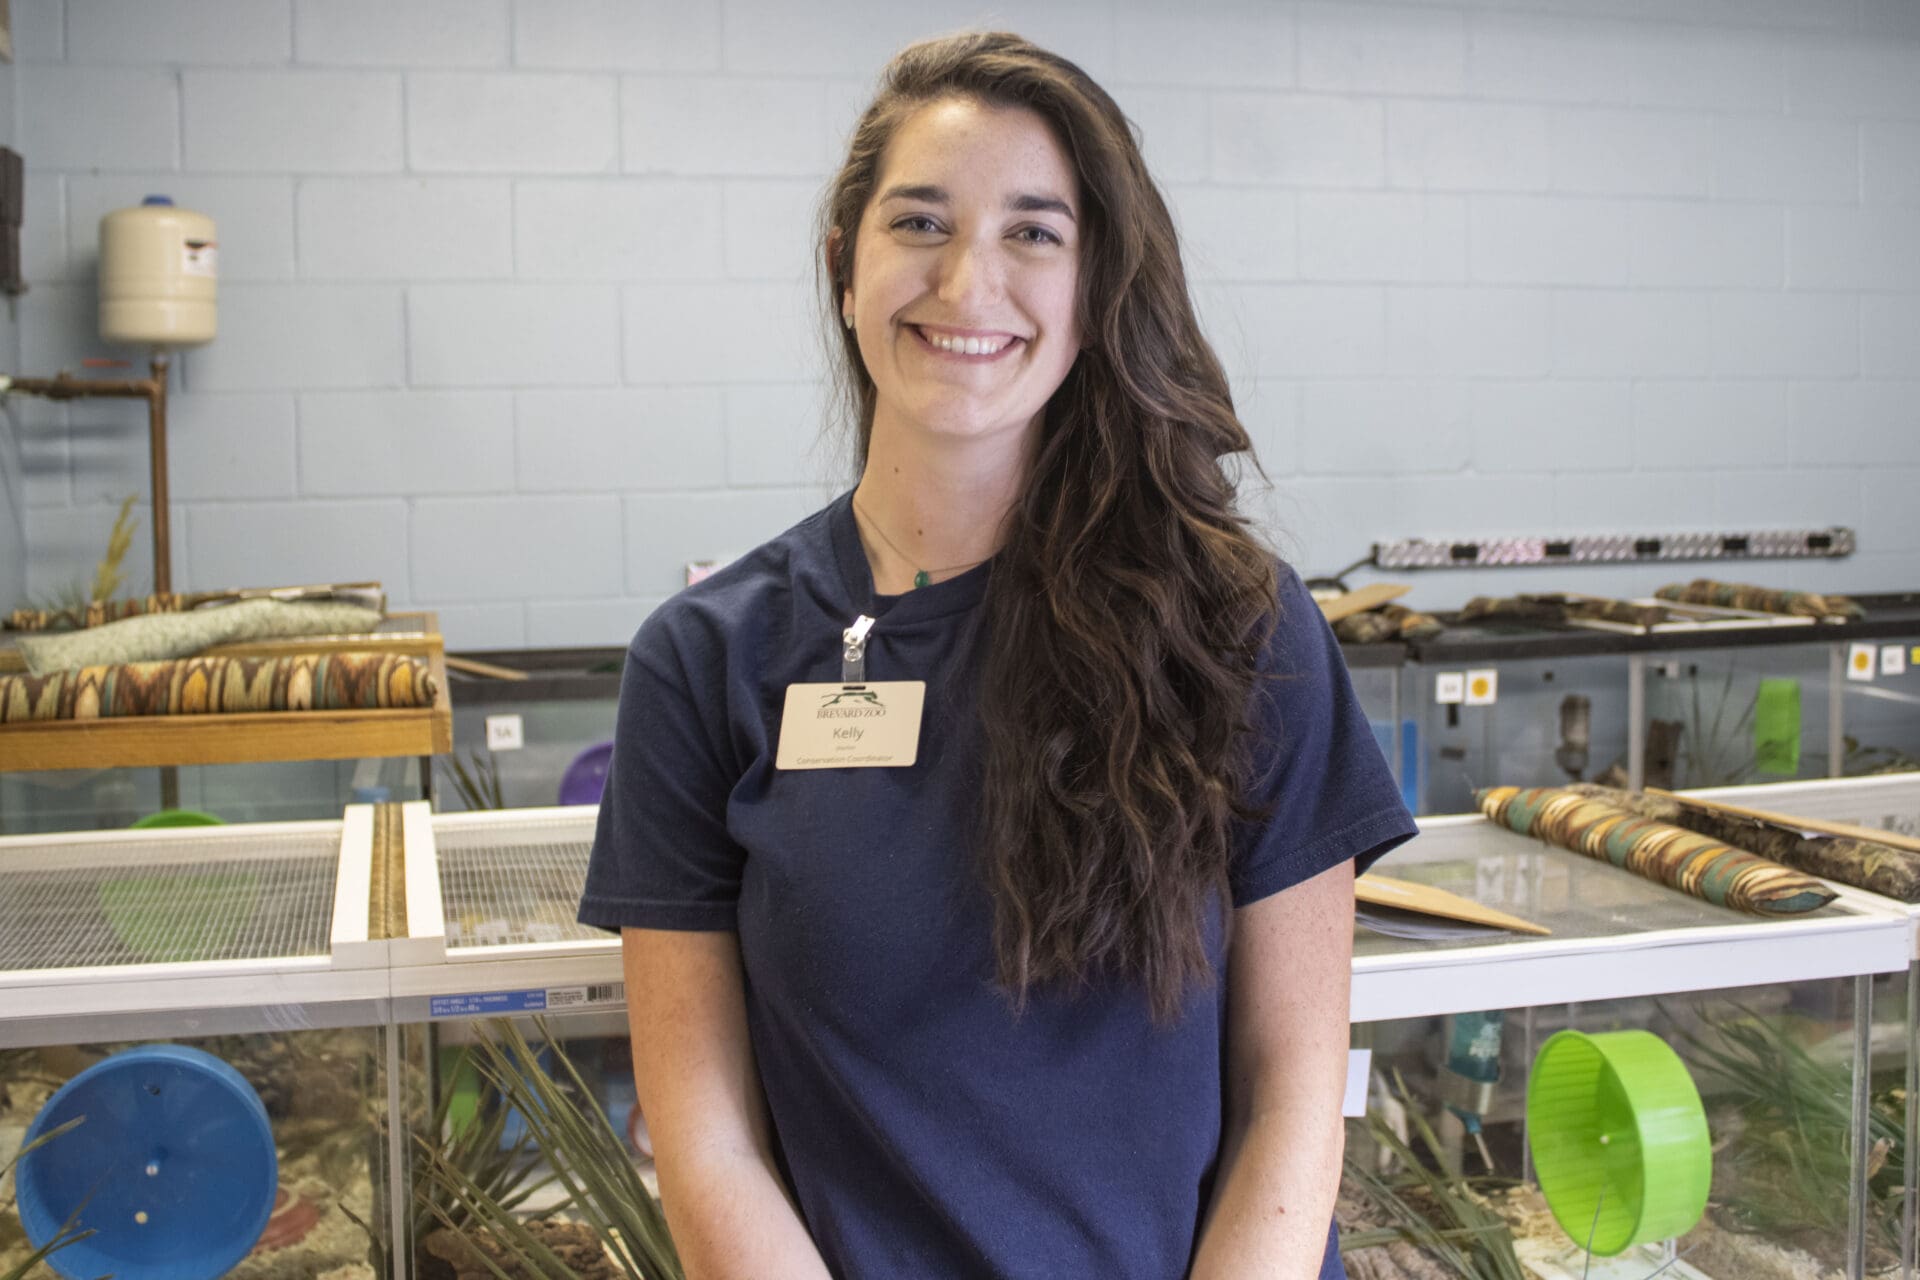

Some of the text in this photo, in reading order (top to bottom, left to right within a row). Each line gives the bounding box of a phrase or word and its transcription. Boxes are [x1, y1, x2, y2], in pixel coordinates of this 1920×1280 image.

[816, 707, 887, 720] BREVARD ZOO
[832, 726, 865, 742] Kelly
